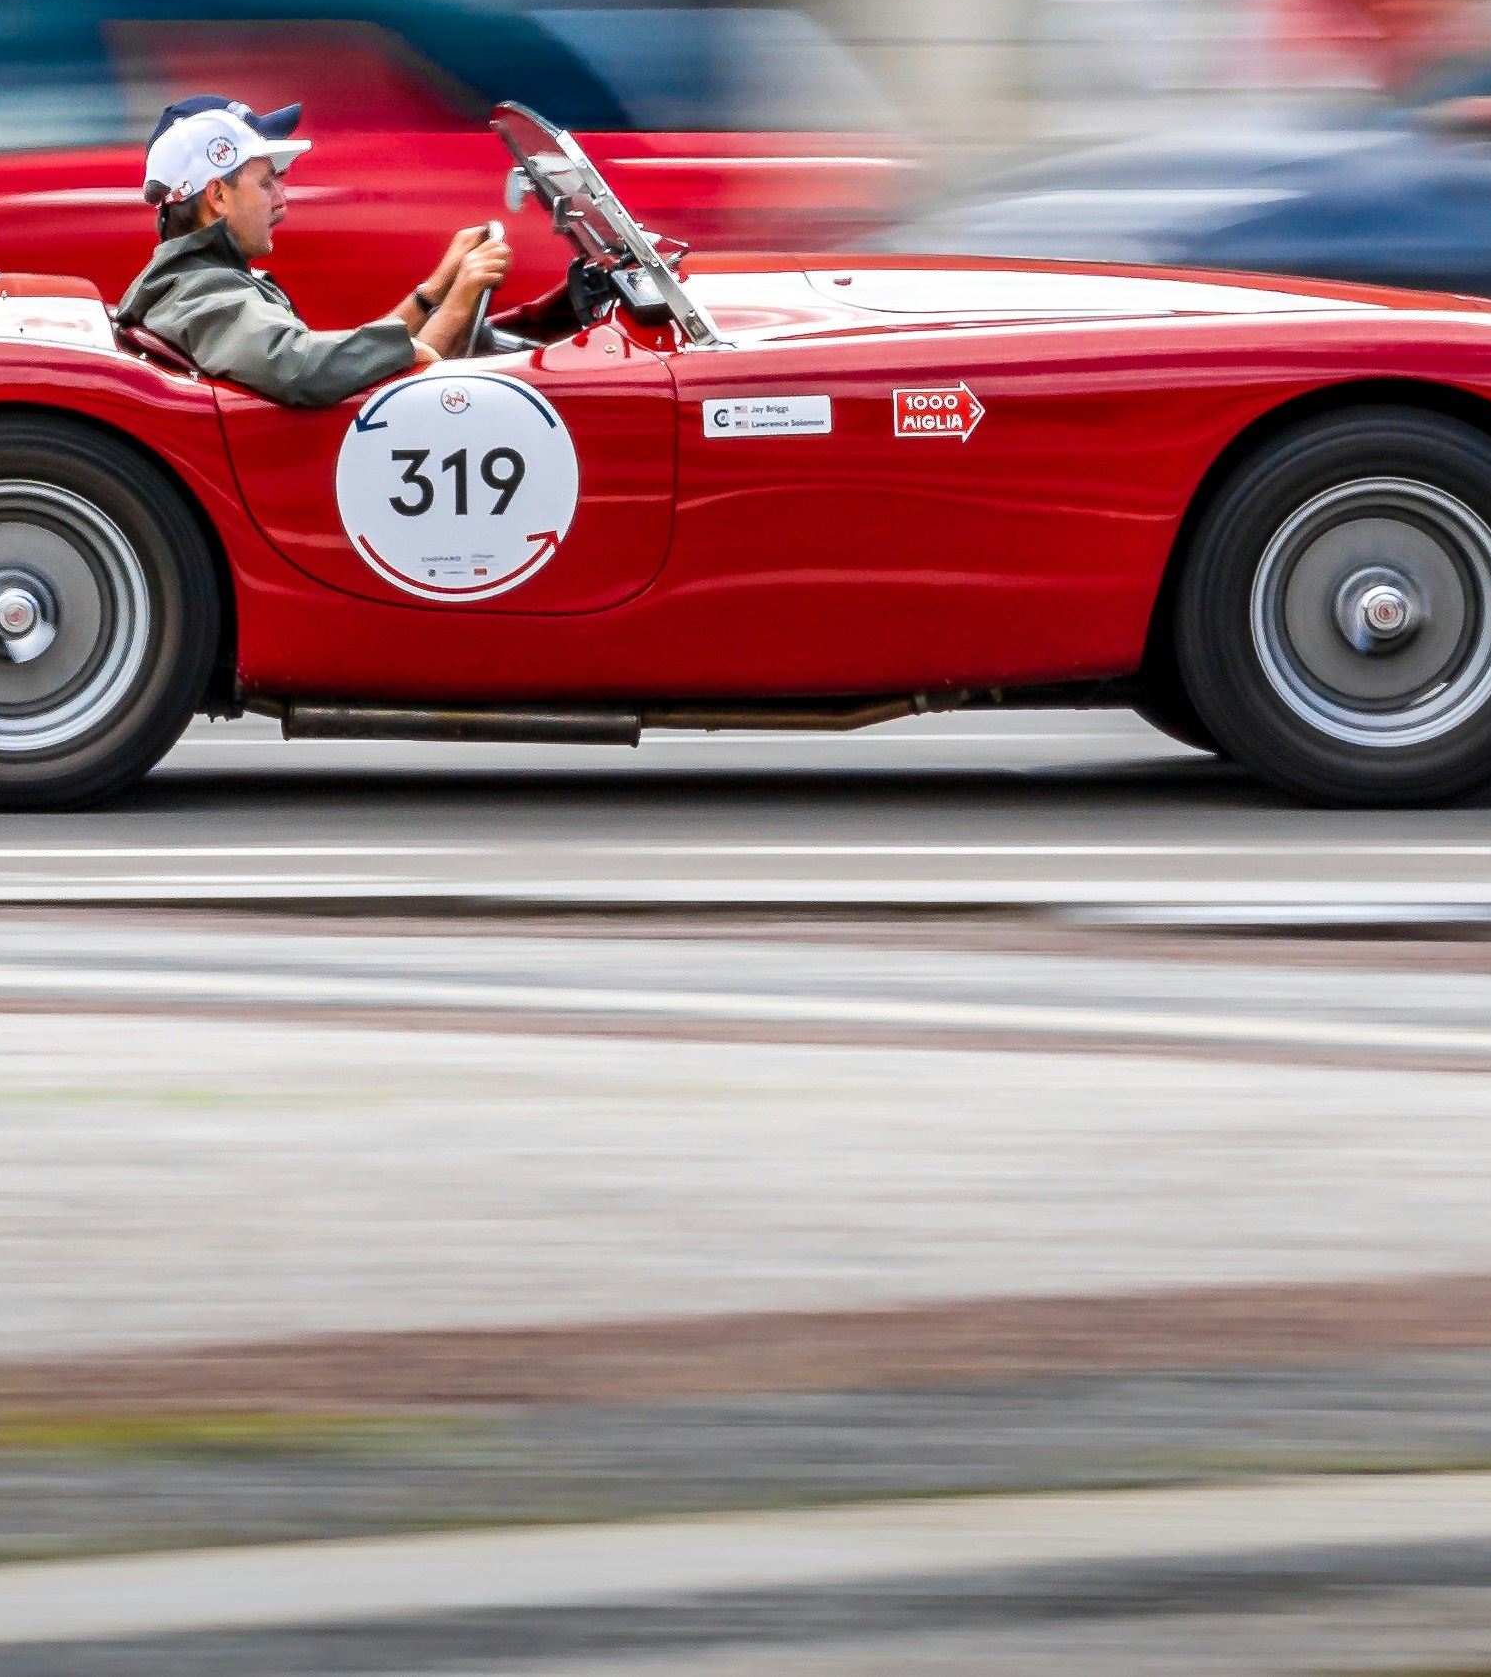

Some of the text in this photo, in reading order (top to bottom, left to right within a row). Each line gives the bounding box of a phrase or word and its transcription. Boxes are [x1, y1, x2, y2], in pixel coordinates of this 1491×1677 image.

[751, 405, 789, 415] Jay Briggs
[905, 394, 958, 411] 1000
[902, 414, 963, 430] MIGLIA
[388, 446, 526, 517] 319
